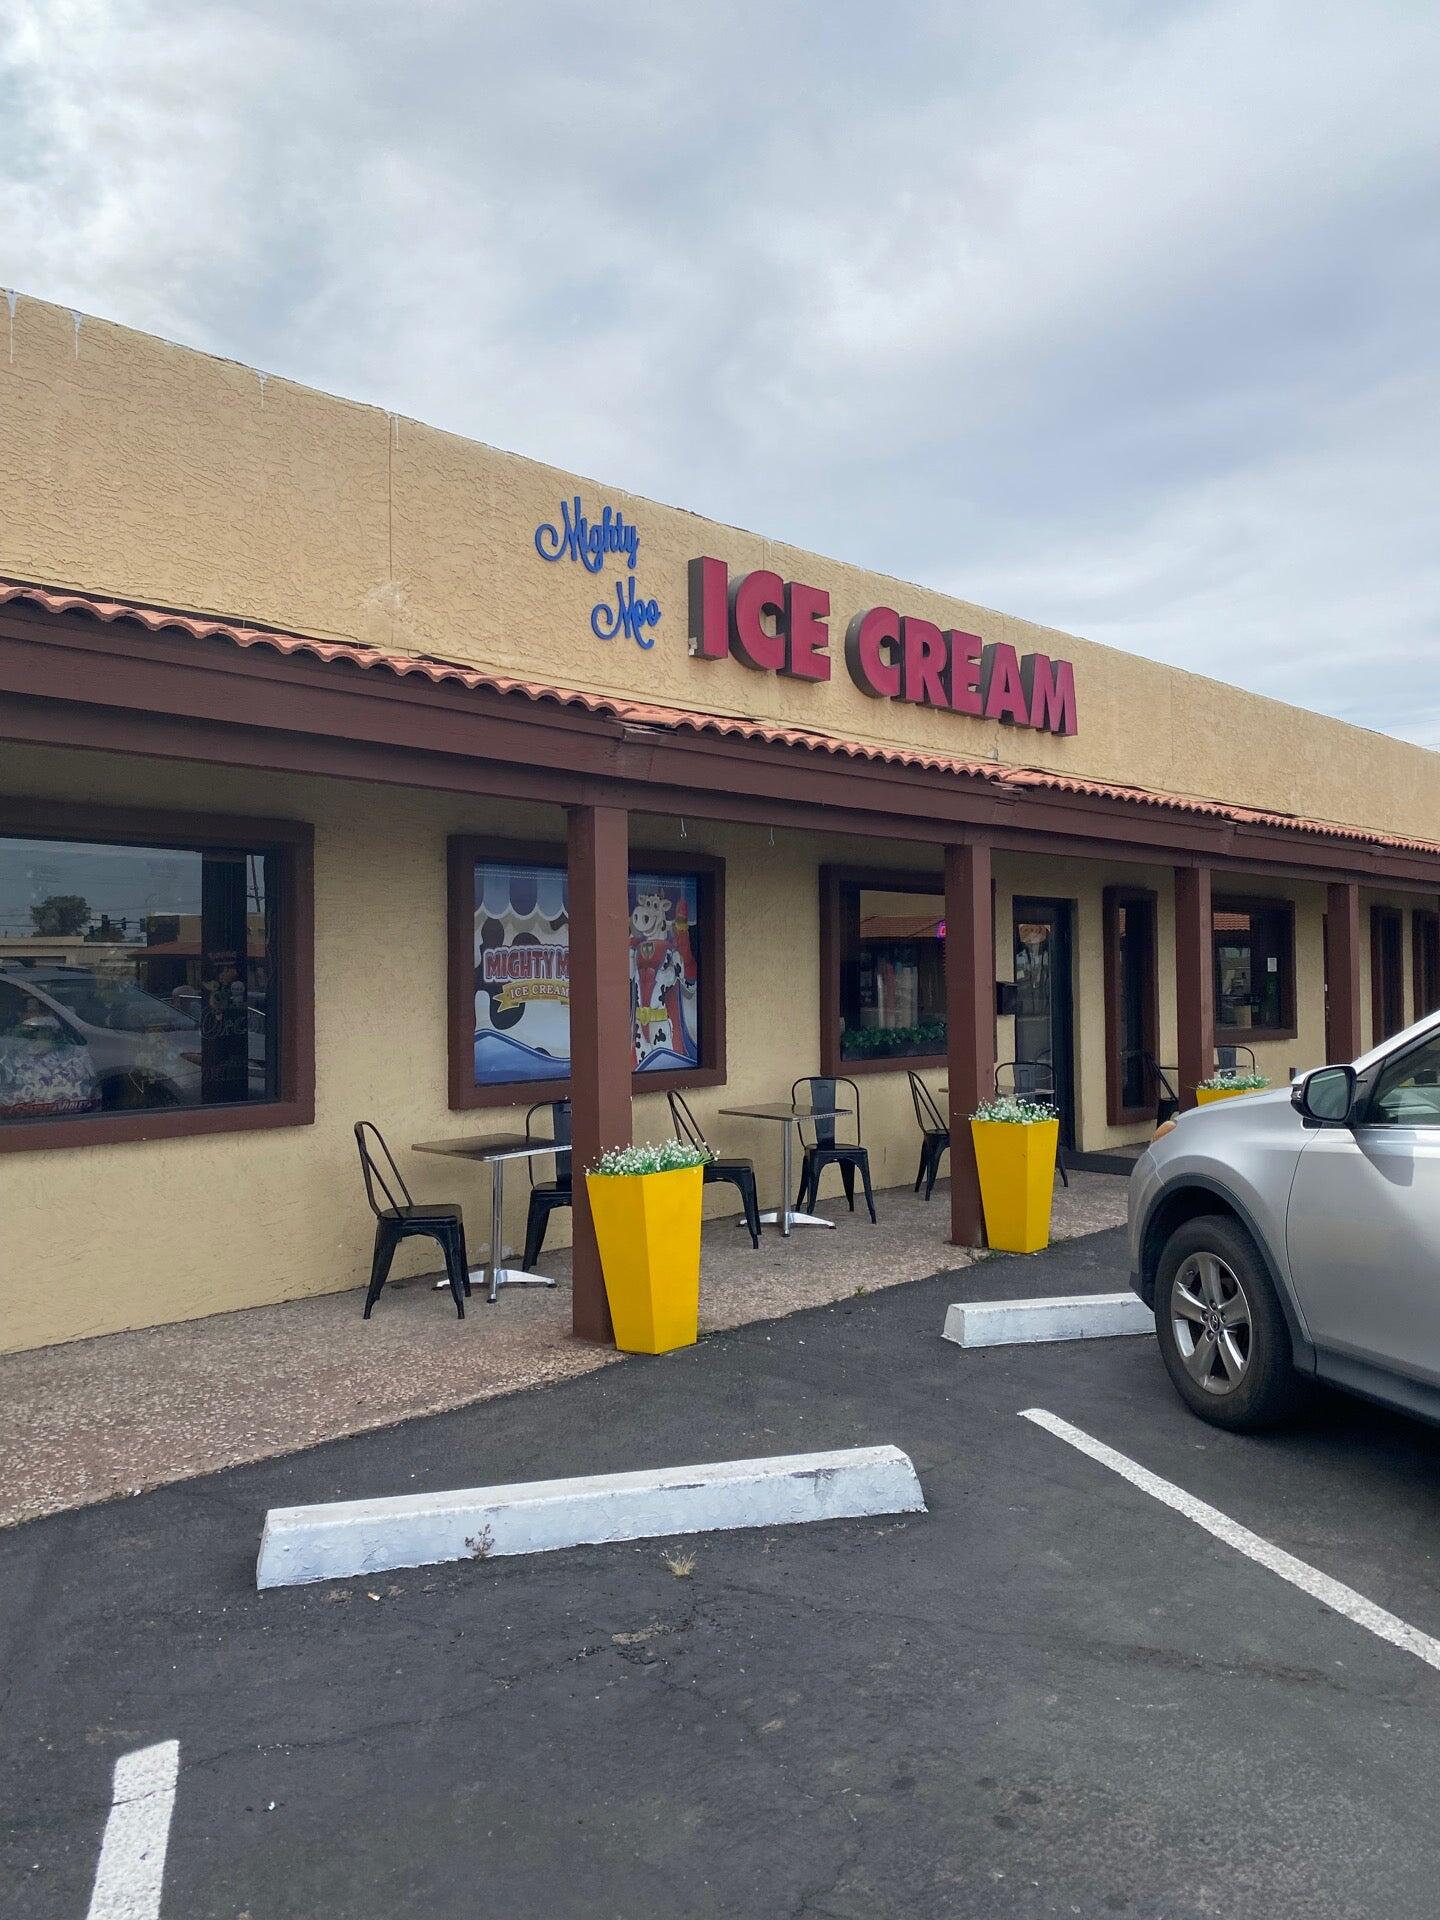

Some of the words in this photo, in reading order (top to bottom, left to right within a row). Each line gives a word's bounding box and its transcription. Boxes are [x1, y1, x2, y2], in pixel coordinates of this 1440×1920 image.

[535, 496, 640, 573] Mighty
[591, 576, 661, 650] Moo
[688, 555, 831, 682] ICE
[845, 605, 1078, 737] CREAM
[485, 947, 555, 980] MIGHTY
[510, 986, 528, 998] ICE
